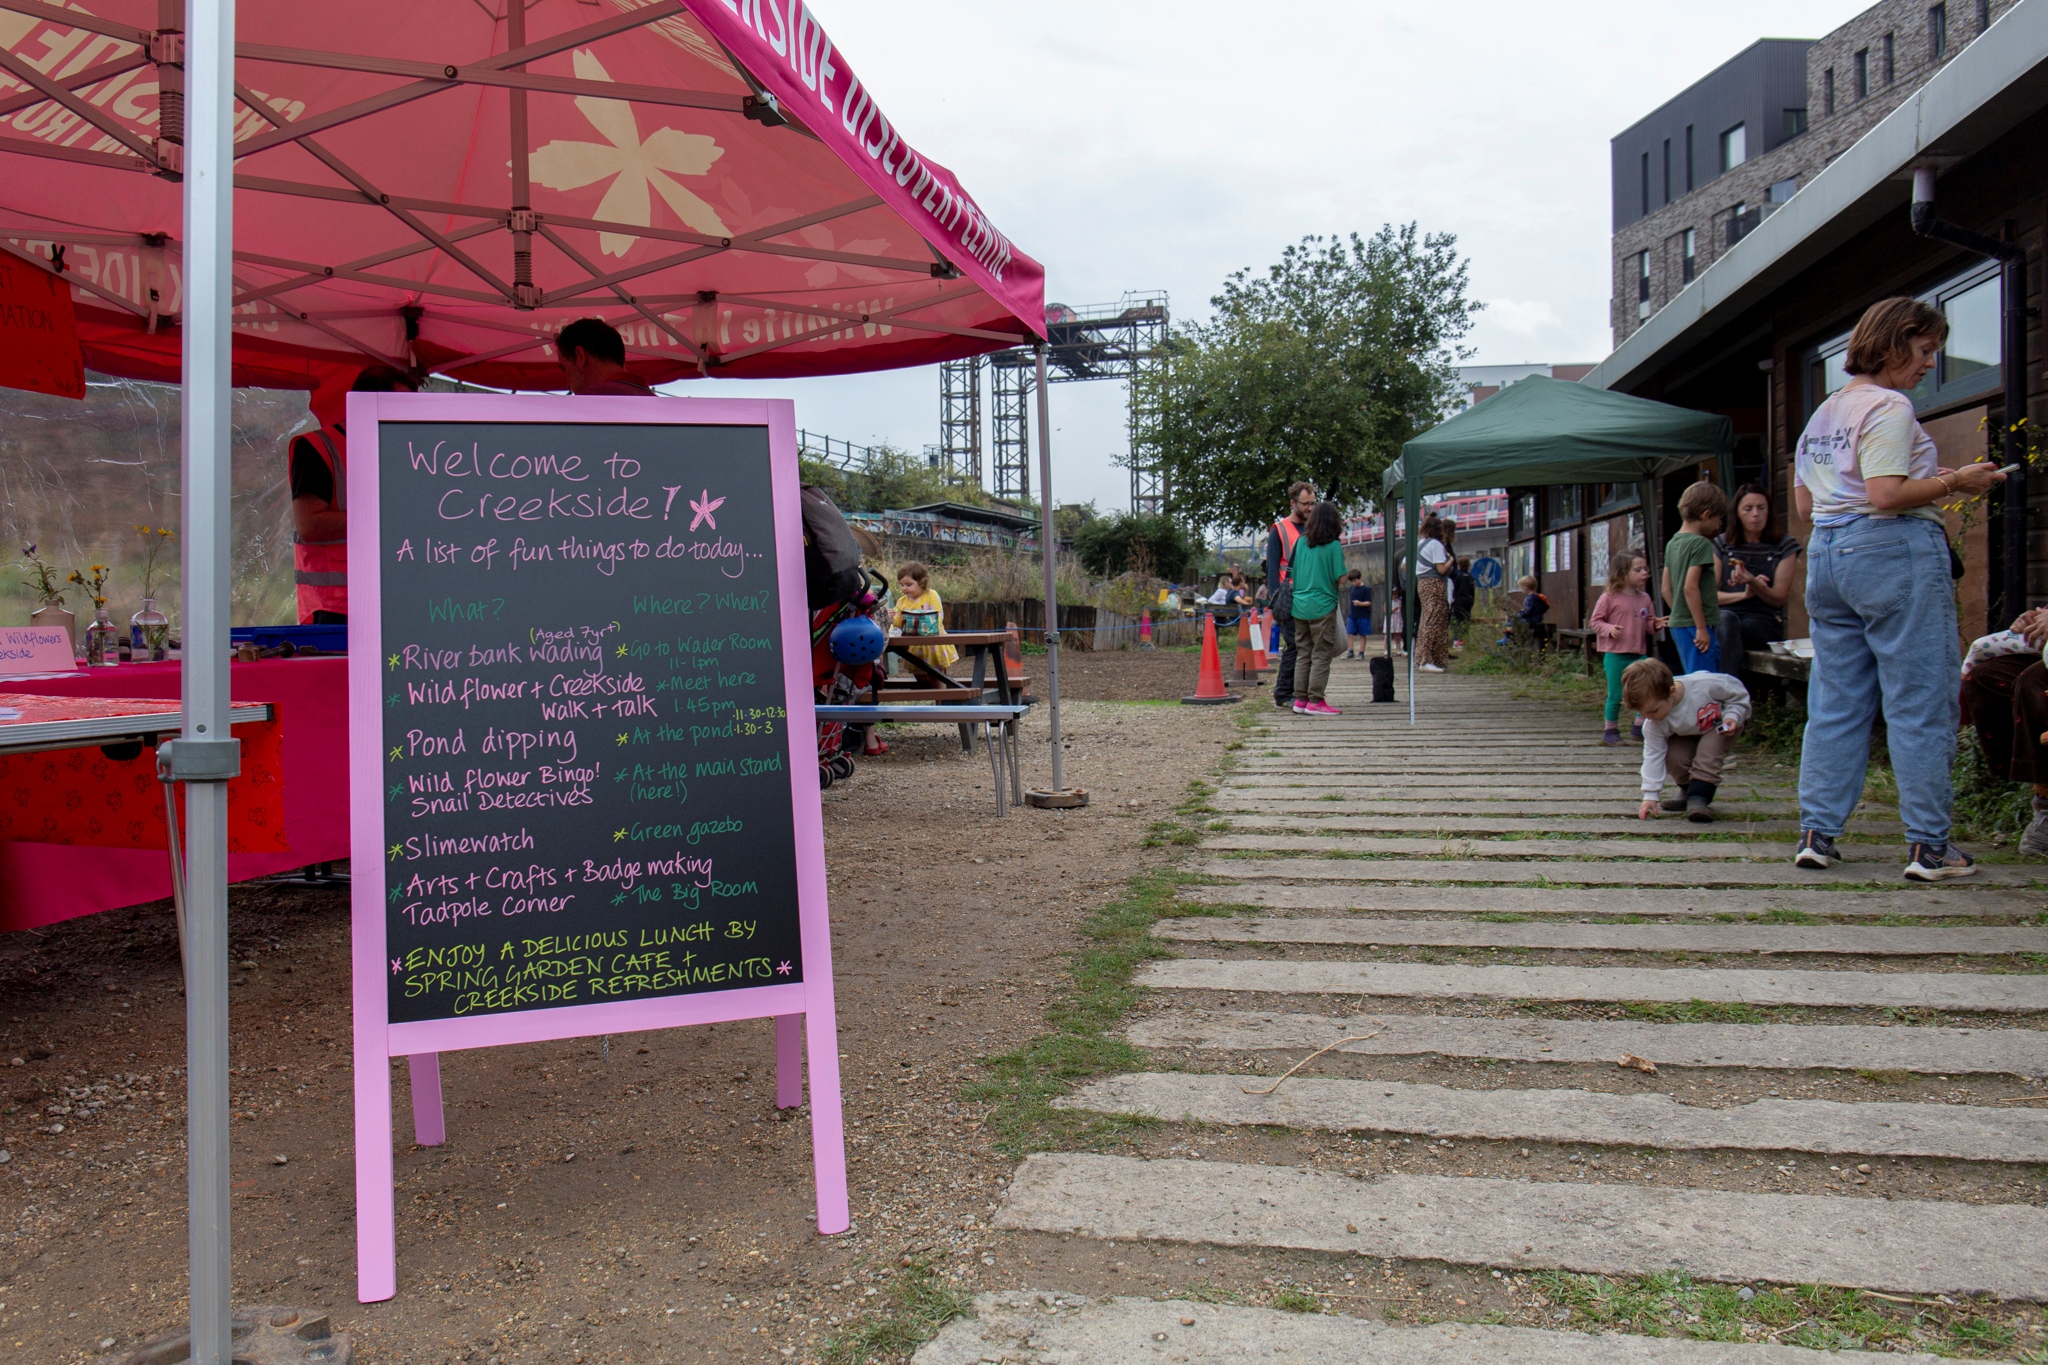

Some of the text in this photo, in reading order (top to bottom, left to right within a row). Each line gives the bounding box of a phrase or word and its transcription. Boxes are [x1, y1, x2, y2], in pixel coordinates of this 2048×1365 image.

[722, 0, 836, 114] SIDE
[409, 440, 641, 481] Welcome to
[397, 539, 414, 562] A
[427, 539, 462, 563] list
[470, 539, 497, 570] of
[509, 538, 553, 570] fun
[558, 536, 626, 575] things
[628, 538, 650, 560] to
[656, 536, 685, 559] do
[429, 598, 505, 623] What?
[633, 590, 770, 614] Where? When?
[6, 631, 62, 647] Wildflowers
[630, 633, 772, 661] Go to Wader Room
[402, 644, 463, 670] River
[469, 642, 522, 667] bank
[549, 672, 645, 697] Creekside
[670, 671, 756, 691] Meet here
[612, 695, 658, 718] talk
[406, 727, 577, 764] Pond dipping
[632, 720, 734, 746] At the pond
[408, 762, 600, 795] Wild flower Bingo!
[632, 763, 655, 781] At
[658, 762, 688, 779] the
[695, 758, 736, 778] main
[411, 788, 594, 818] Snail Detectives
[630, 780, 688, 805] (here!)
[405, 827, 535, 860] Slimewatch
[630, 815, 743, 845] Green gazebo
[407, 873, 459, 897] Arts
[485, 864, 557, 895] Crafts
[582, 859, 643, 890] Badge
[647, 851, 713, 888] making
[631, 880, 759, 910] The Big Room
[402, 895, 576, 927] Tadpole Corner
[405, 920, 757, 971] ENJOY A DELICIOUS LUNCH BY
[404, 965, 499, 998] SPRING
[505, 956, 604, 986] GARDEN
[611, 951, 672, 974] CAFE
[453, 957, 773, 1014] CREEKSIDE REFRESHMENTS
